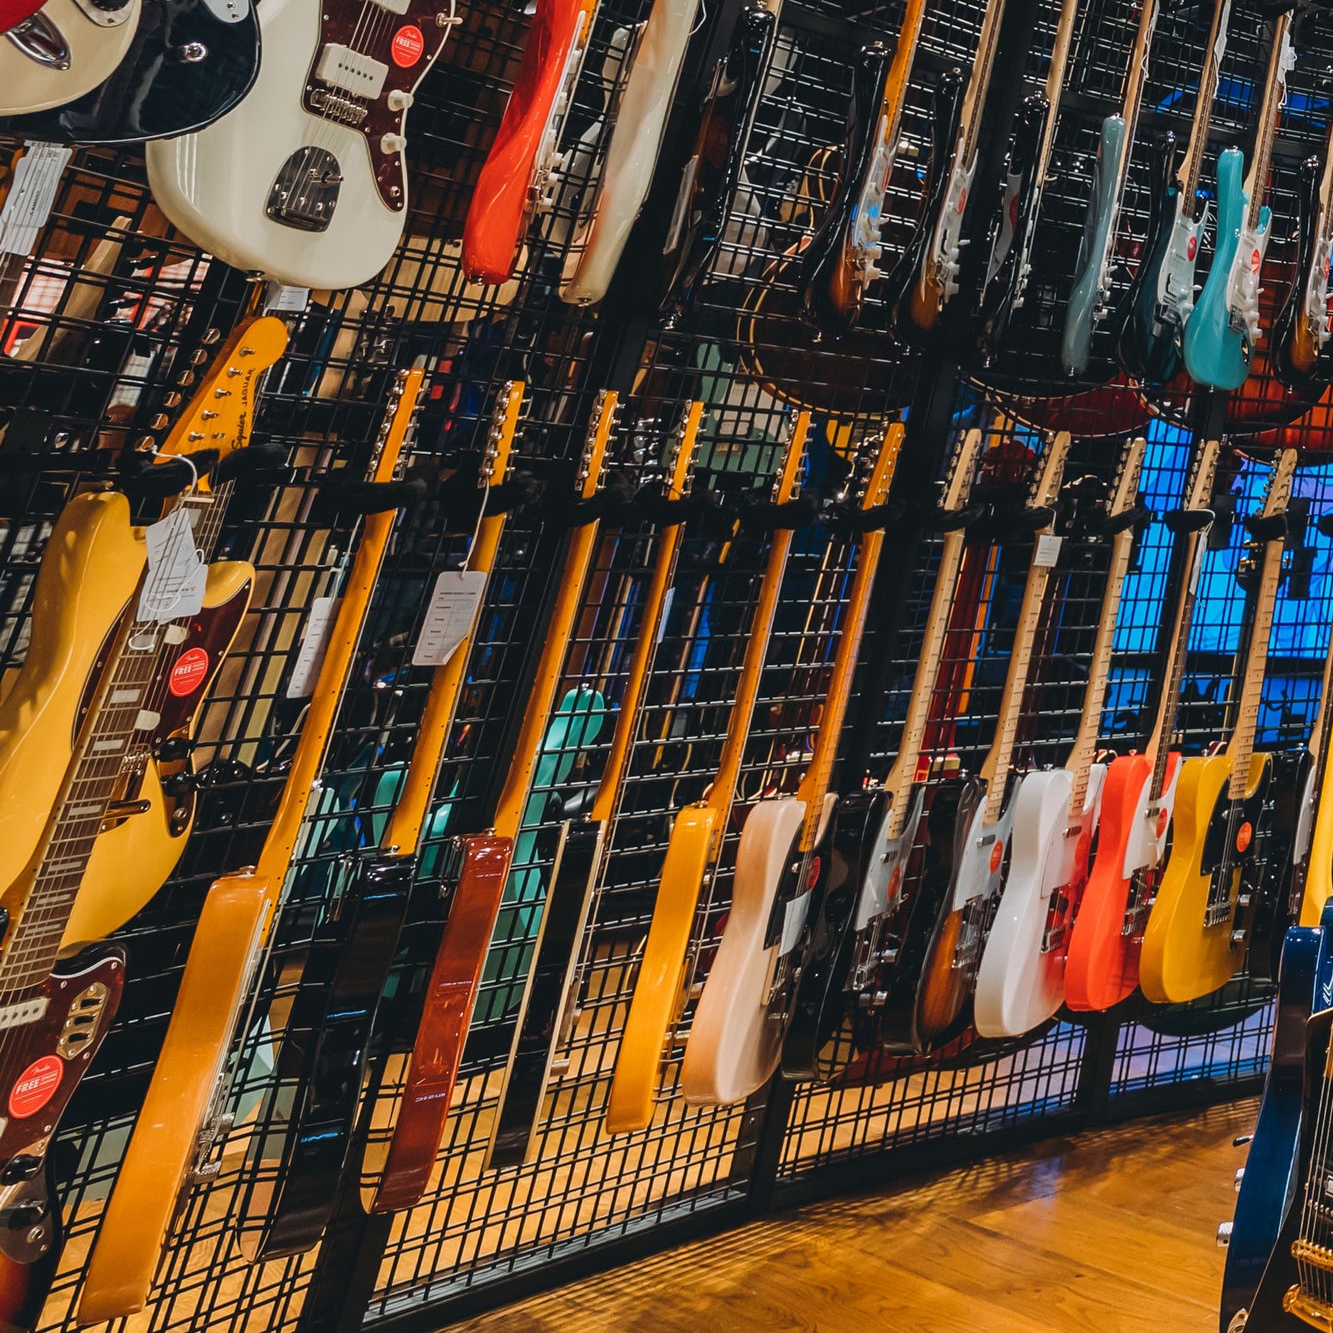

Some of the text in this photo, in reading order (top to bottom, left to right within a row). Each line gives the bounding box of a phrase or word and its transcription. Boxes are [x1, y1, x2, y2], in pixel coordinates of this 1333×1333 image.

[242, 368, 256, 406] JAGUAR
[231, 412, 248, 450] Squier
[174, 664, 193, 677] FREE
[15, 1077, 41, 1095] FREE
